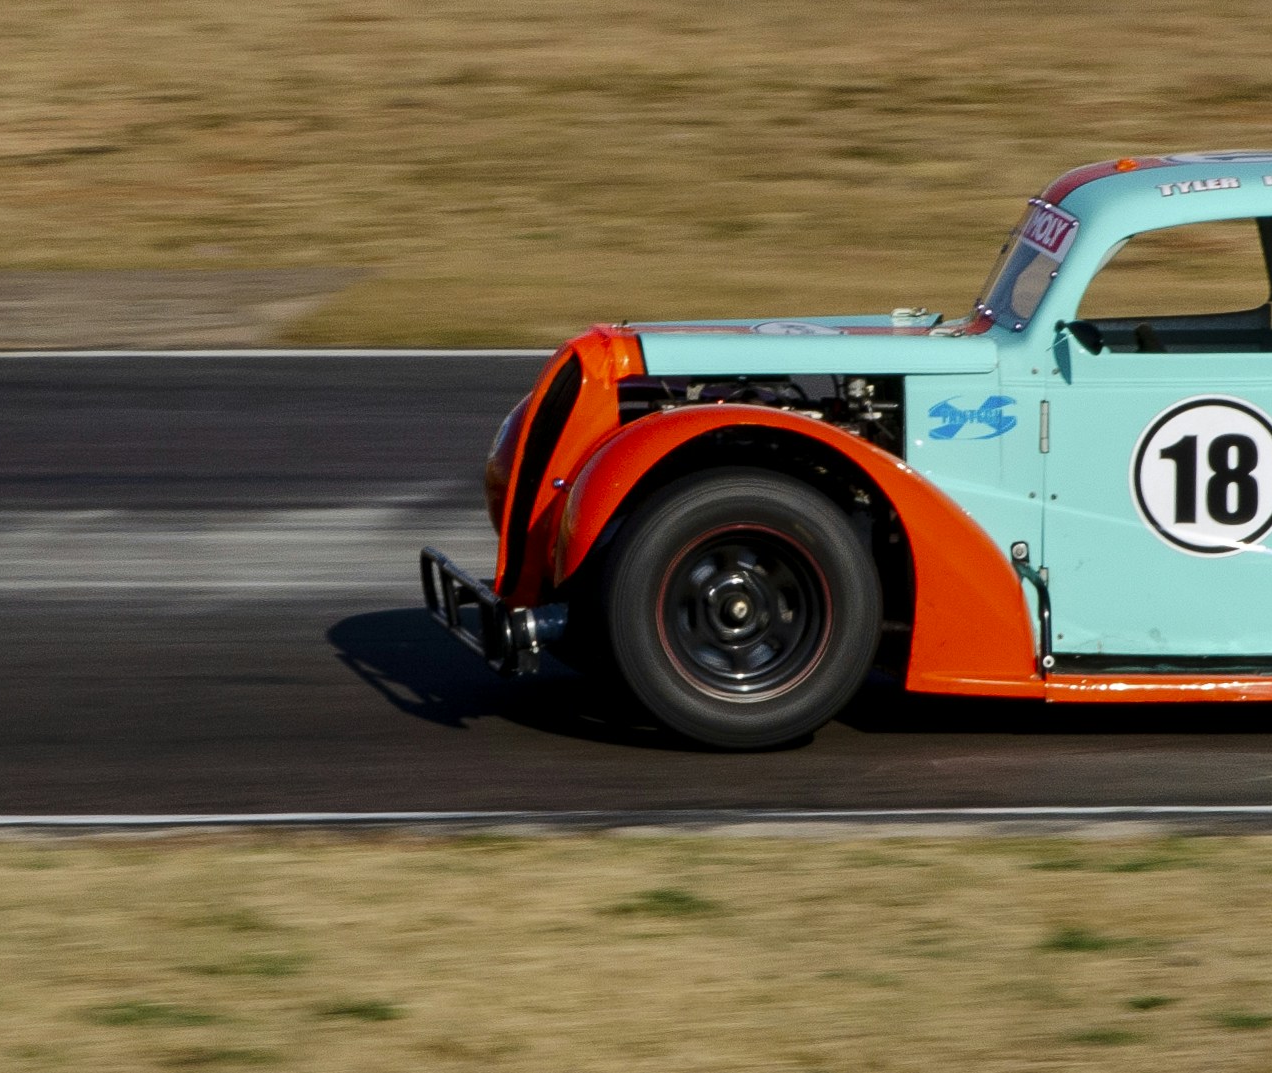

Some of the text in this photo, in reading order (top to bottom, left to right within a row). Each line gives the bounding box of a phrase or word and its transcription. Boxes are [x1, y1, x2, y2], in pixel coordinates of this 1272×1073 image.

[1157, 178, 1240, 197] TYLER
[1024, 208, 1070, 248] MOLY
[1159, 433, 1259, 525] 18
